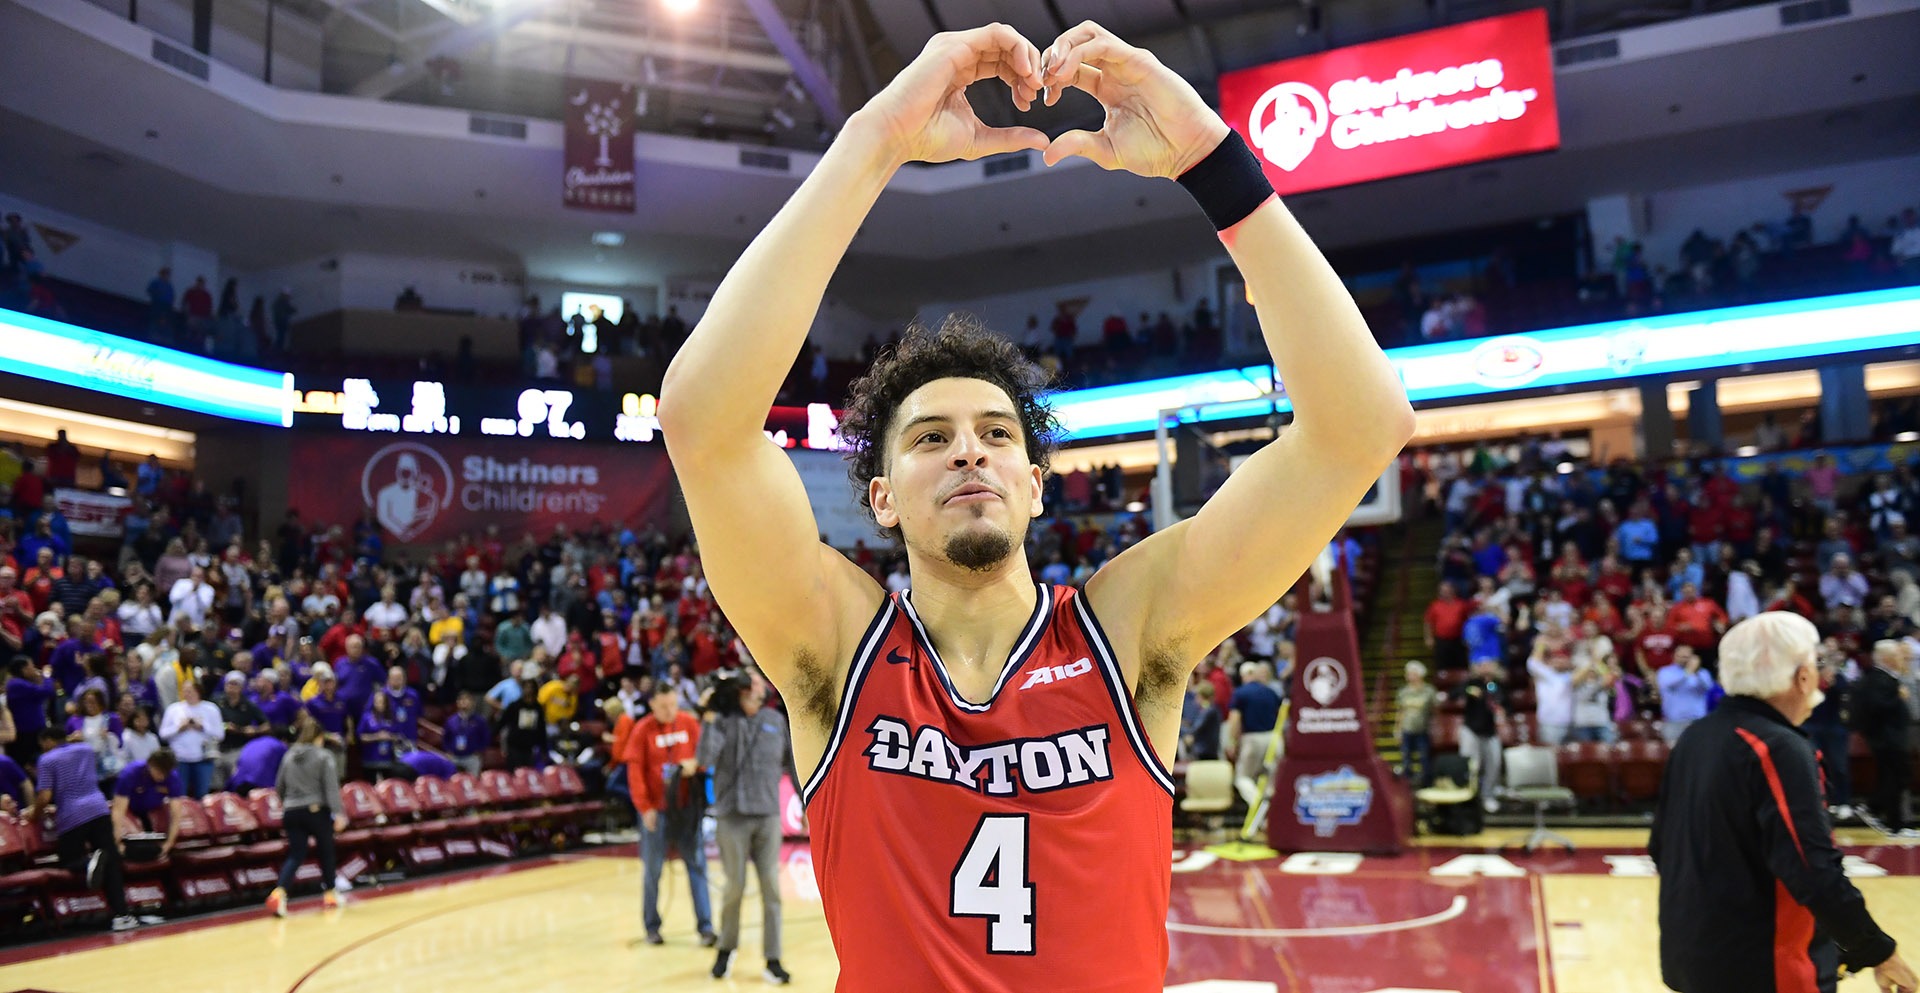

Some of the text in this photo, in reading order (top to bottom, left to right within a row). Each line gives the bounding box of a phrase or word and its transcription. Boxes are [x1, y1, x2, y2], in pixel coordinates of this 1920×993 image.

[462, 454, 599, 485] Shriners
[1018, 657, 1093, 690] A10
[862, 714, 1114, 797] DAYTON
[950, 812, 1036, 955] 4
